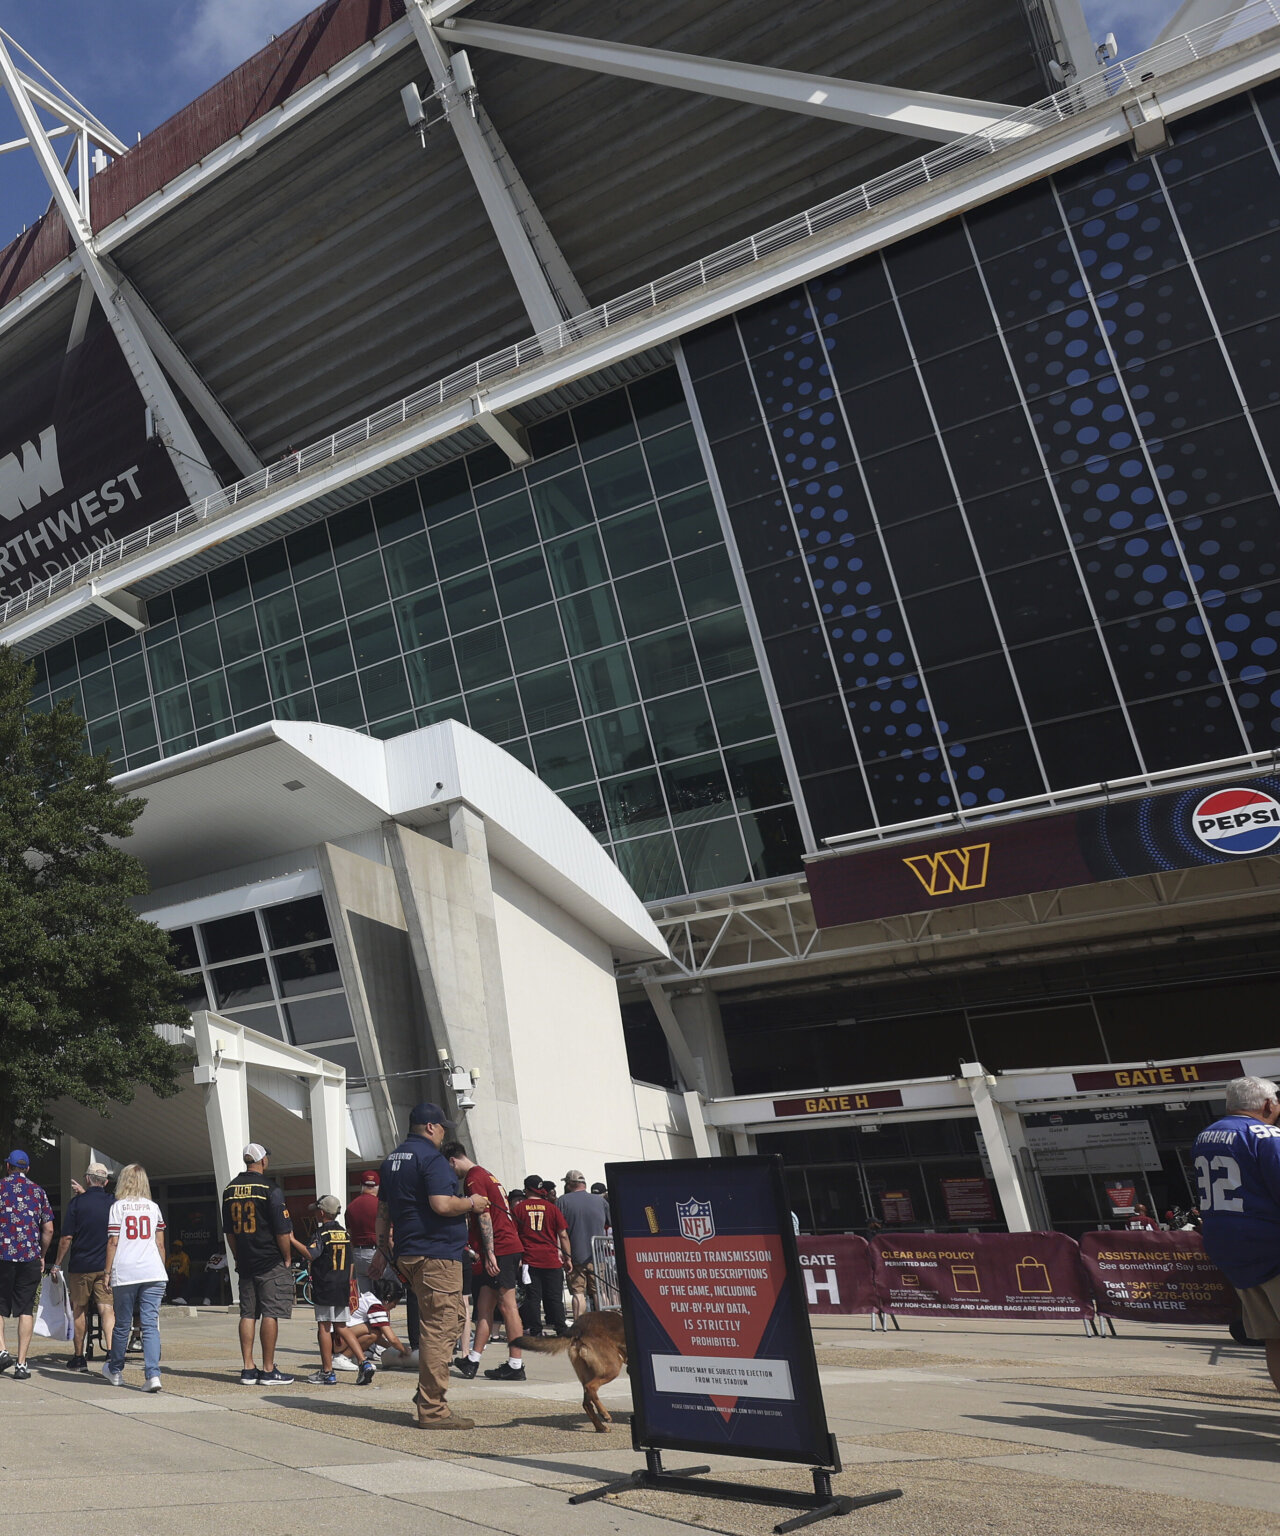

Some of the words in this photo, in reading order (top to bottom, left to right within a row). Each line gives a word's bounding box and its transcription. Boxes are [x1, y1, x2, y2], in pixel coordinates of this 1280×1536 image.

[1198, 808, 1280, 833] PEPSI
[1114, 1068, 1175, 1087] GATE
[1180, 1066, 1199, 1081] H
[805, 1096, 851, 1112] GATE
[855, 1095, 869, 1109] H
[1094, 1112, 1129, 1120] PEPSI
[234, 1186, 252, 1197] ALLEN
[230, 1201, 257, 1234] 93
[528, 1211, 544, 1231] 17
[125, 1215, 151, 1240] 80
[683, 1218, 711, 1237] NFL
[332, 1244, 346, 1270] 17
[636, 1251, 701, 1262] UNAUTHORIZED
[703, 1250, 772, 1262] TRANSMISSION
[798, 1254, 836, 1266] GATE
[881, 1251, 914, 1259] CLEAR
[915, 1251, 937, 1259] BAG
[938, 1252, 975, 1260] POLICY
[1097, 1252, 1170, 1260] ASSISTANCE
[1099, 1262, 1117, 1270] See
[1119, 1262, 1174, 1272] something?
[1176, 1263, 1194, 1272] Say
[644, 1269, 654, 1279] OF
[656, 1269, 695, 1279] ACCOUNTS
[697, 1269, 708, 1279] OR
[709, 1268, 768, 1279] DESCRIPTIONS
[660, 1285, 669, 1295] OF
[671, 1285, 686, 1296] THE
[687, 1285, 713, 1297] GAME,
[714, 1286, 757, 1296] INCLUDING
[803, 1269, 840, 1305] H
[1103, 1281, 1125, 1289] Text
[1106, 1290, 1129, 1299] Call
[1131, 1291, 1212, 1300] 301-276-6100
[671, 1302, 725, 1313] PLAY-BY-PLAY
[727, 1303, 751, 1315] DATA,
[1124, 1301, 1151, 1309] scan
[1153, 1301, 1187, 1310] HERE
[684, 1318, 694, 1330] IS
[696, 1319, 741, 1331] STRICTLY
[691, 1336, 740, 1347] PROHIBITED.
[669, 1366, 696, 1374] VIOLATORS
[715, 1368, 738, 1376] SUBJECT
[746, 1370, 773, 1378] EJECTION
[723, 1378, 748, 1386] STADIUM
